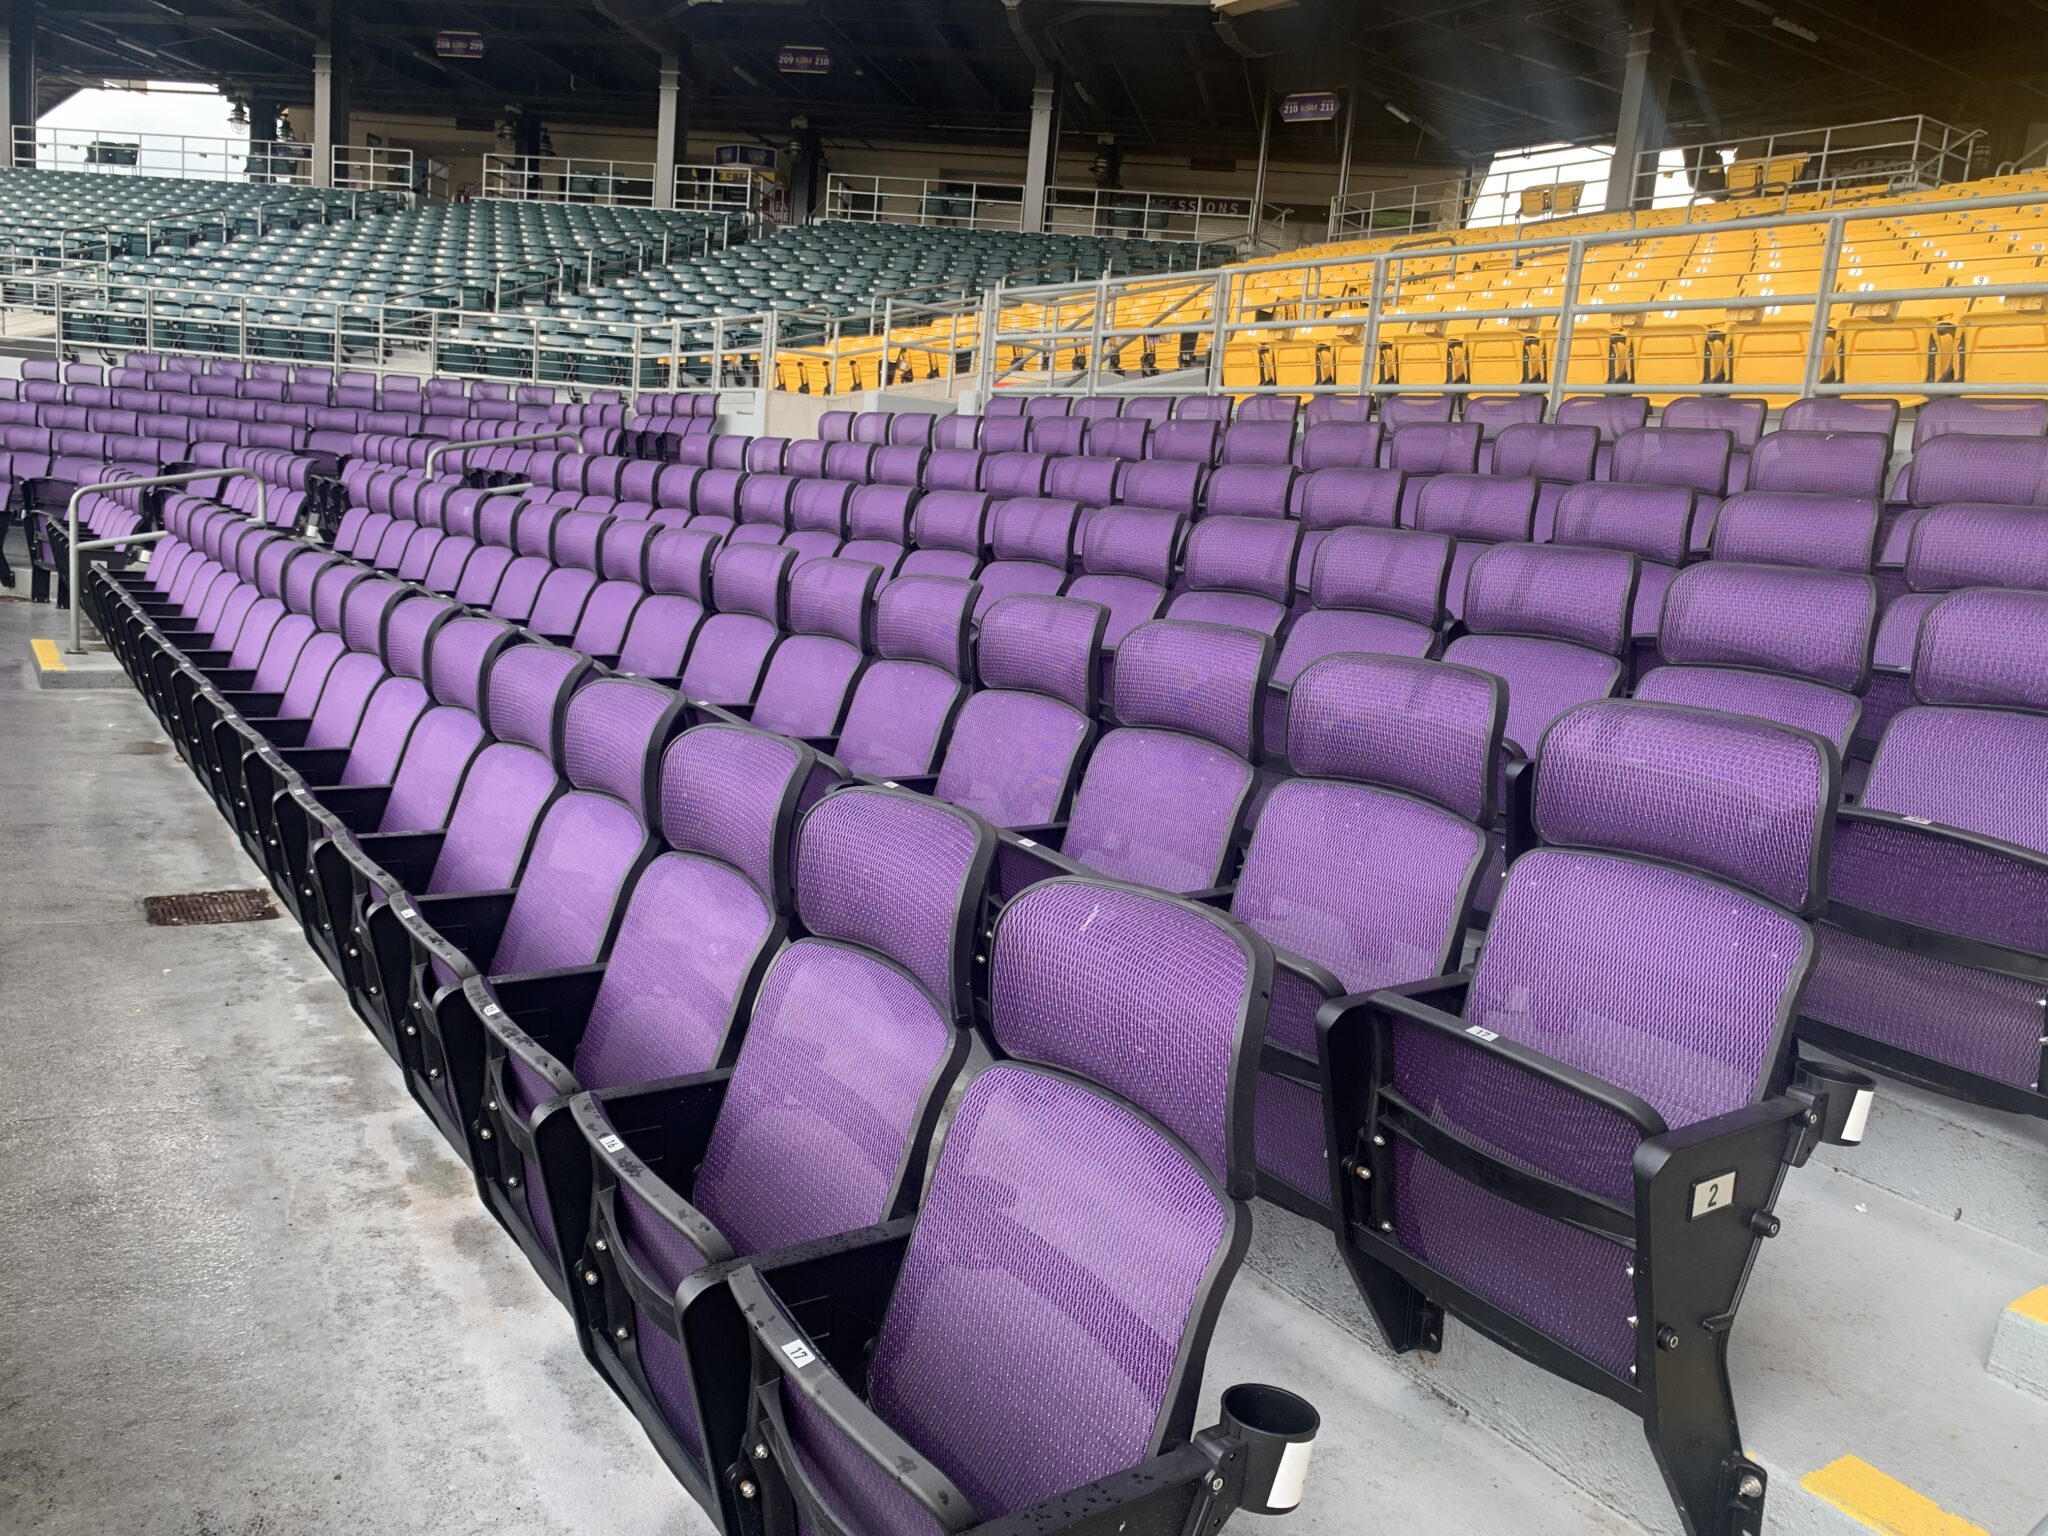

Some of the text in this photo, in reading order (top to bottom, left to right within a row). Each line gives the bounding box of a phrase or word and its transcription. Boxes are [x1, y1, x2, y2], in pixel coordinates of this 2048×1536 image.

[469, 42, 484, 50] 209
[779, 55, 794, 64] 209
[815, 57, 829, 65] 210
[1283, 105, 1298, 114] 210
[1320, 103, 1334, 112] 211
[605, 1139, 619, 1148] 16
[1707, 1183, 1718, 1208] 2
[790, 1347, 808, 1359] 17
